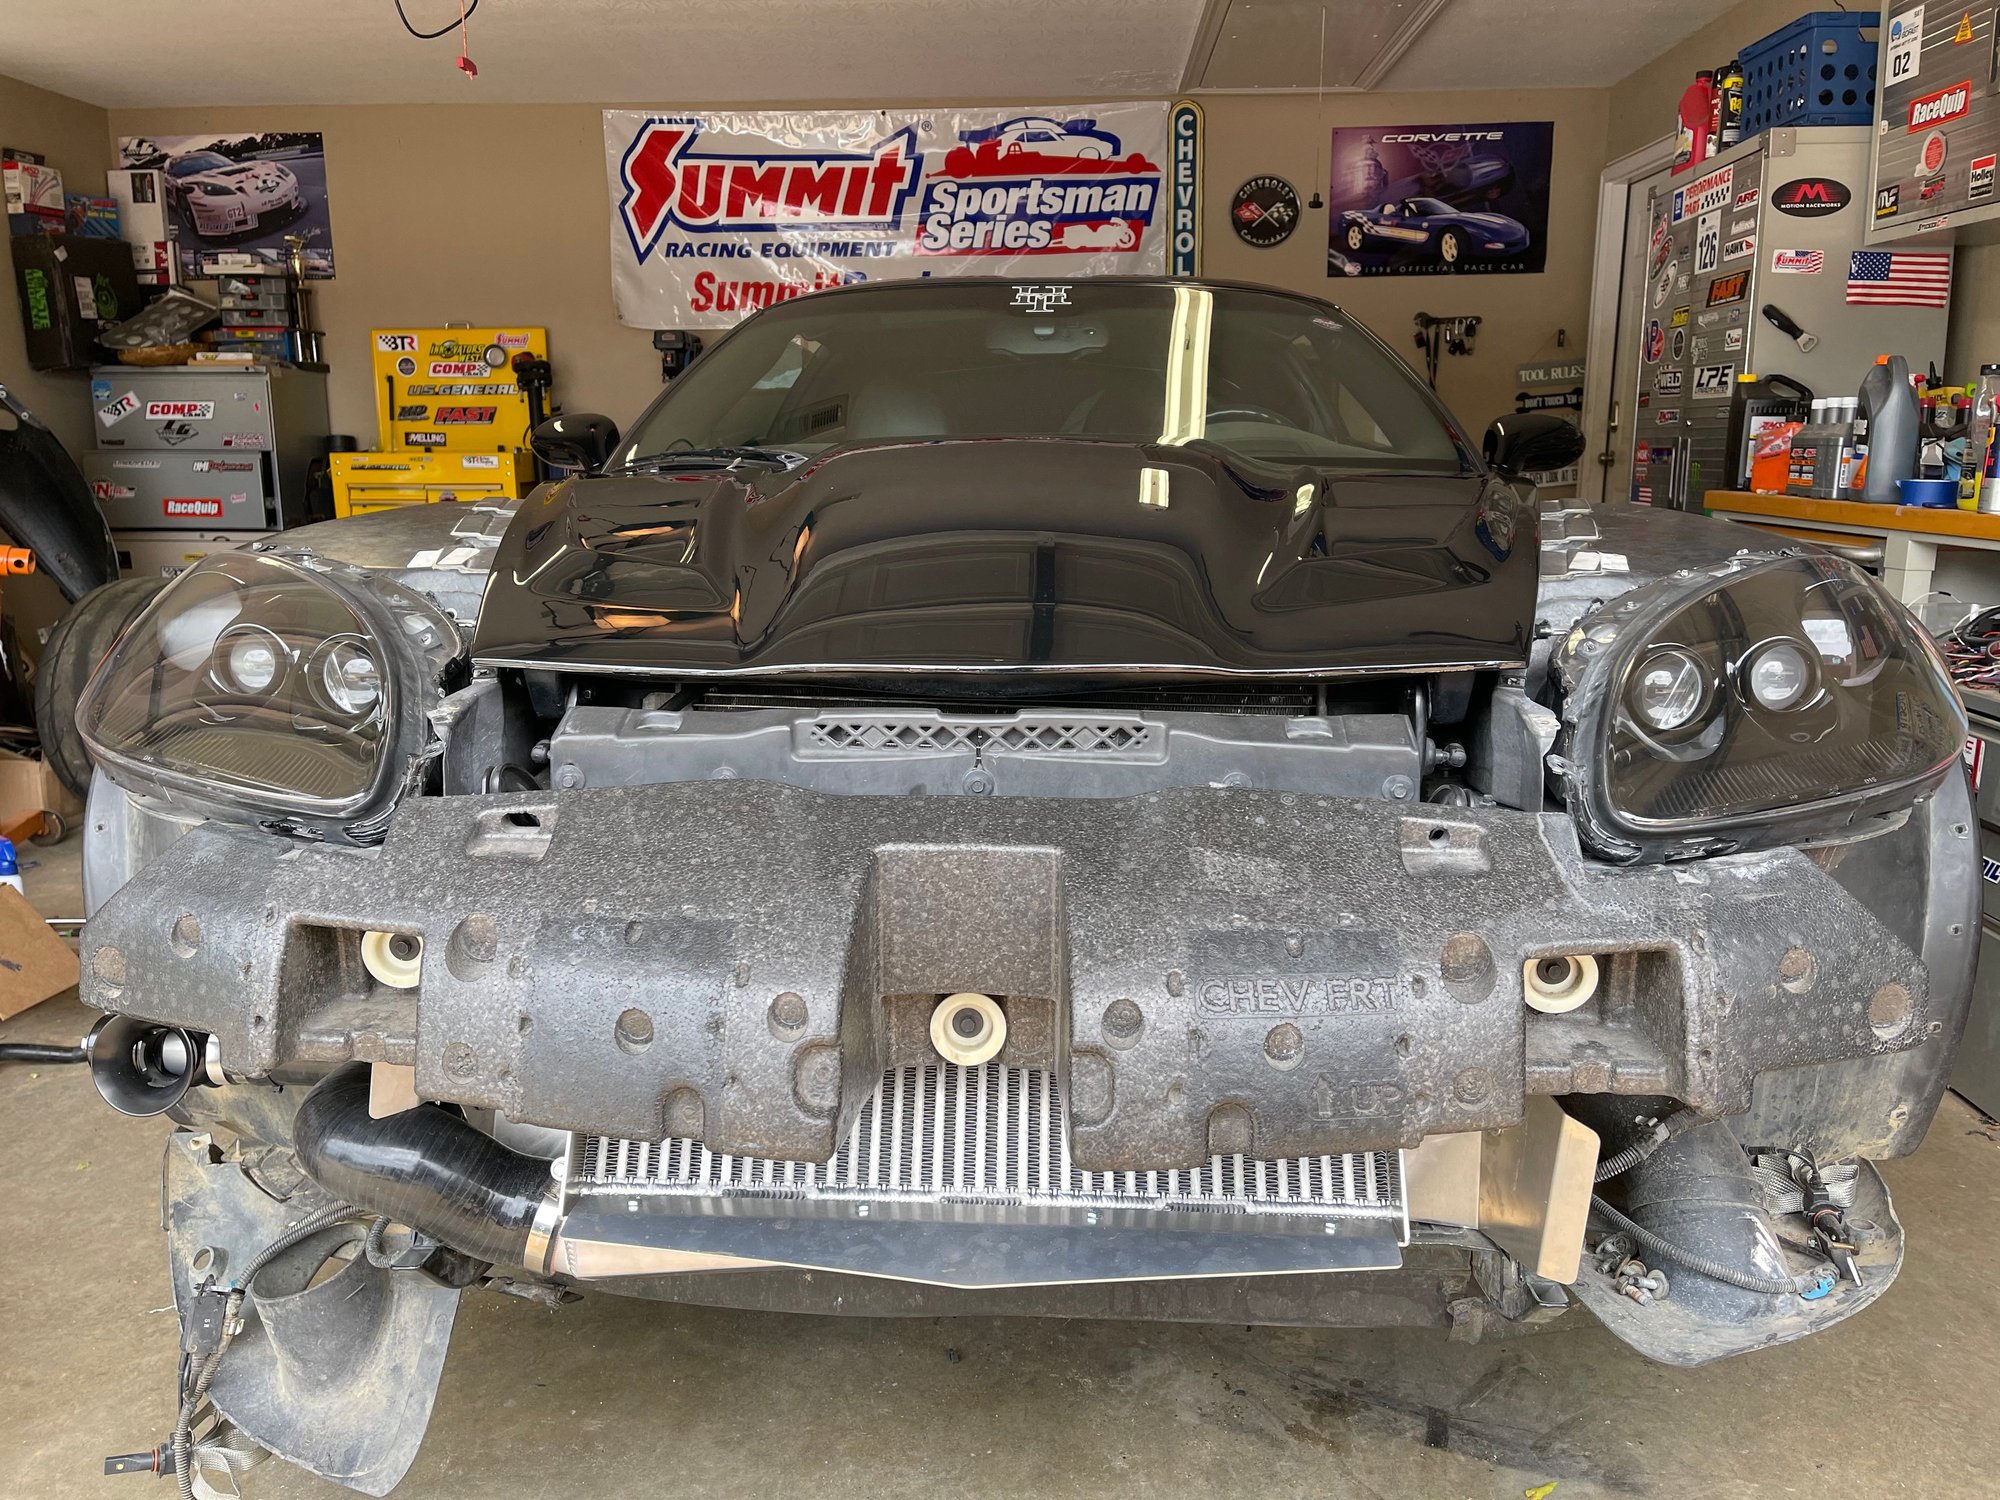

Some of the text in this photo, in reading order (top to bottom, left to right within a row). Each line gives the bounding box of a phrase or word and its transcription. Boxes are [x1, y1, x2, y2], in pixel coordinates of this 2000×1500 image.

[1893, 51, 1911, 78] 02
[1912, 88, 1966, 126] RaceQuip
[1381, 131, 1504, 143] CORVETTE
[1971, 169, 1995, 184] Holley
[1239, 176, 1295, 201] CHEVROLET
[928, 181, 1152, 222] Sportsman
[1736, 191, 1758, 205] ARP
[924, 211, 1053, 250] Series
[665, 241, 897, 259] RACING EQUIPMENT
[1698, 232, 1717, 270] 126
[1725, 241, 1744, 257] HAWK
[1400, 264, 1456, 273] OFFICIAL
[1464, 263, 1494, 272] PACE
[1500, 262, 1525, 271] CAR
[1711, 276, 1744, 301] FAST
[432, 364, 477, 375] COMP
[1519, 370, 1548, 383] TOOL
[1696, 365, 1733, 388] LPE
[149, 404, 198, 416] COMP
[436, 407, 496, 421] FAST
[408, 433, 445, 444] MELLING
[167, 501, 219, 516] RaceQuip
[1200, 976, 1399, 1015] CHEV FRT
